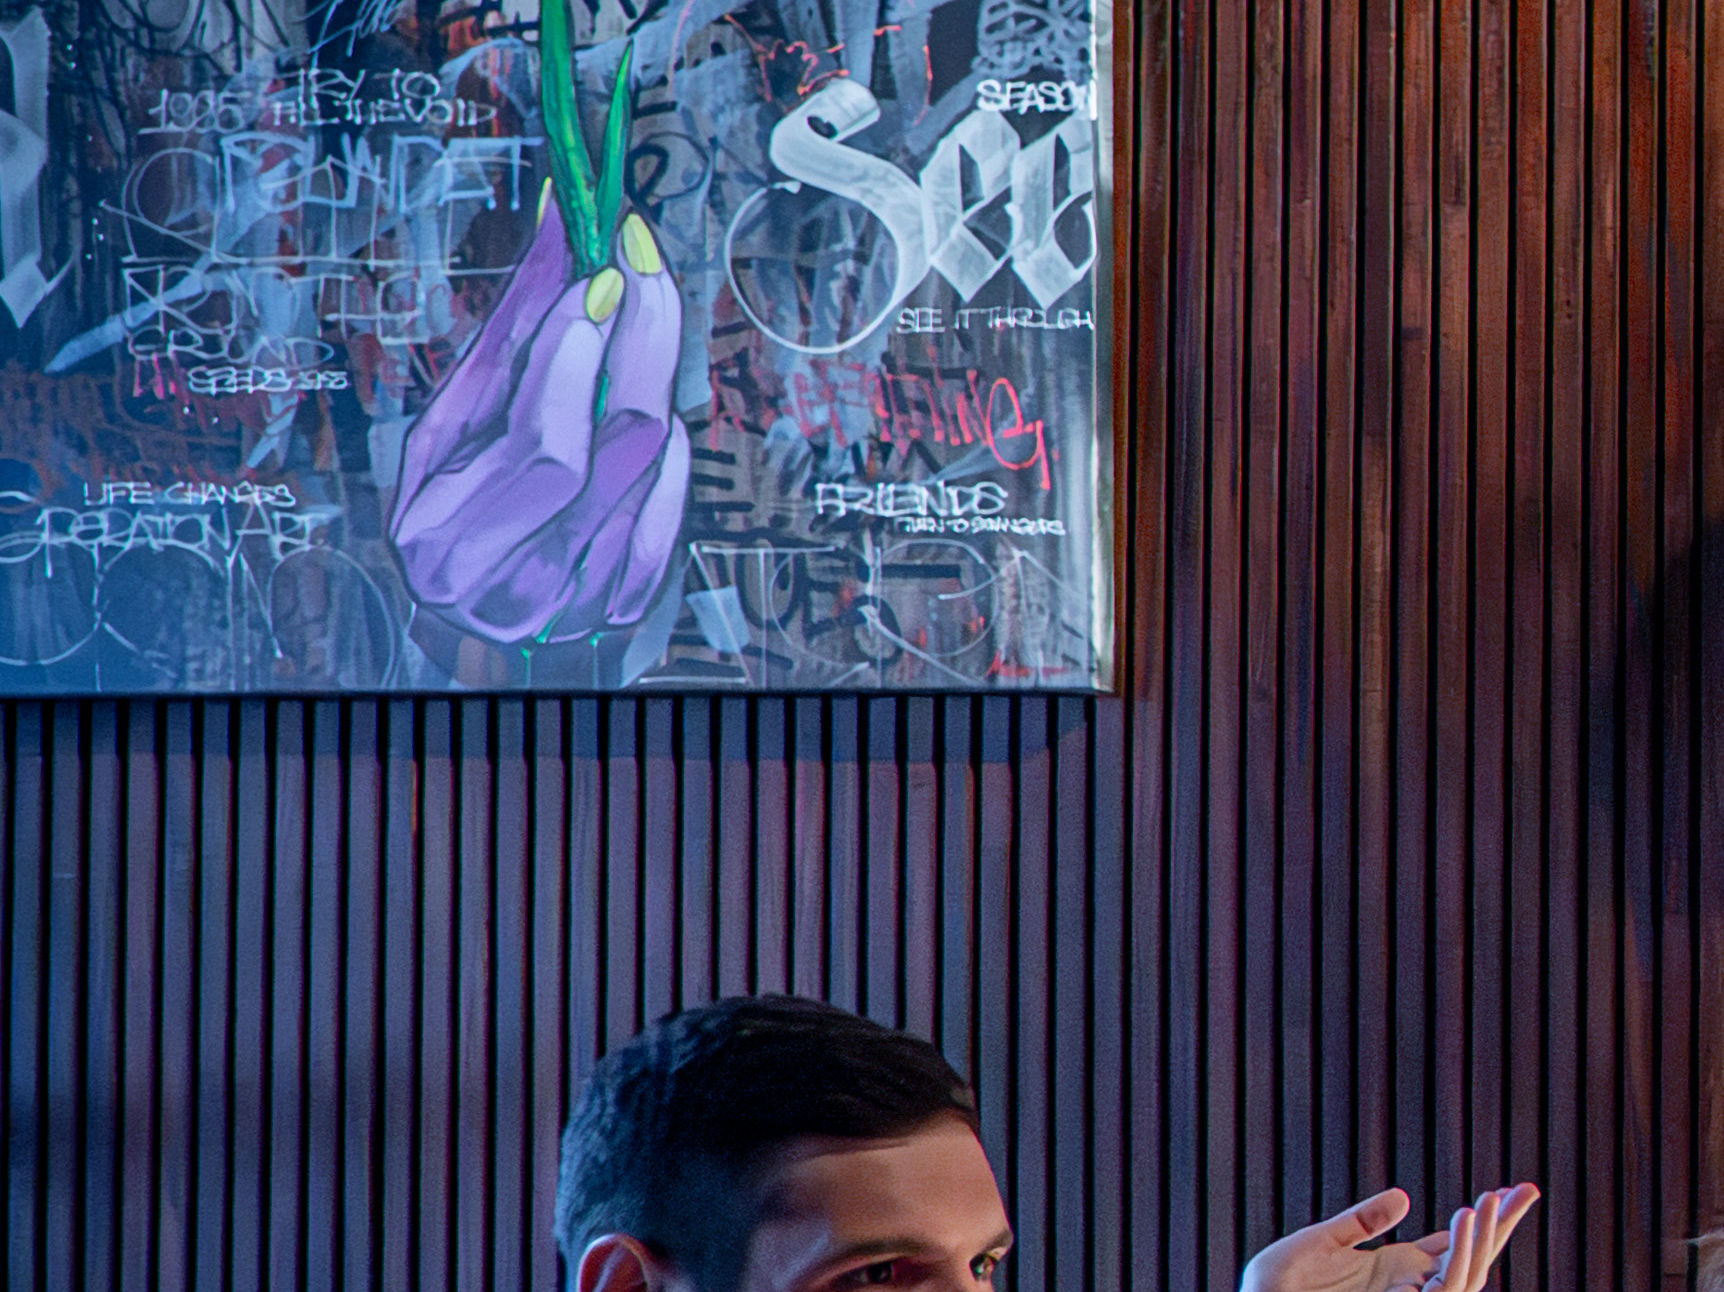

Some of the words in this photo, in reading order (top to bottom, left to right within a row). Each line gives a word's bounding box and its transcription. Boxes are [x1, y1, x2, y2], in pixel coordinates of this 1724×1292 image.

[895, 306, 946, 335] SEE
[83, 481, 154, 507] LIFE
[815, 481, 1009, 517] FRIENDS
